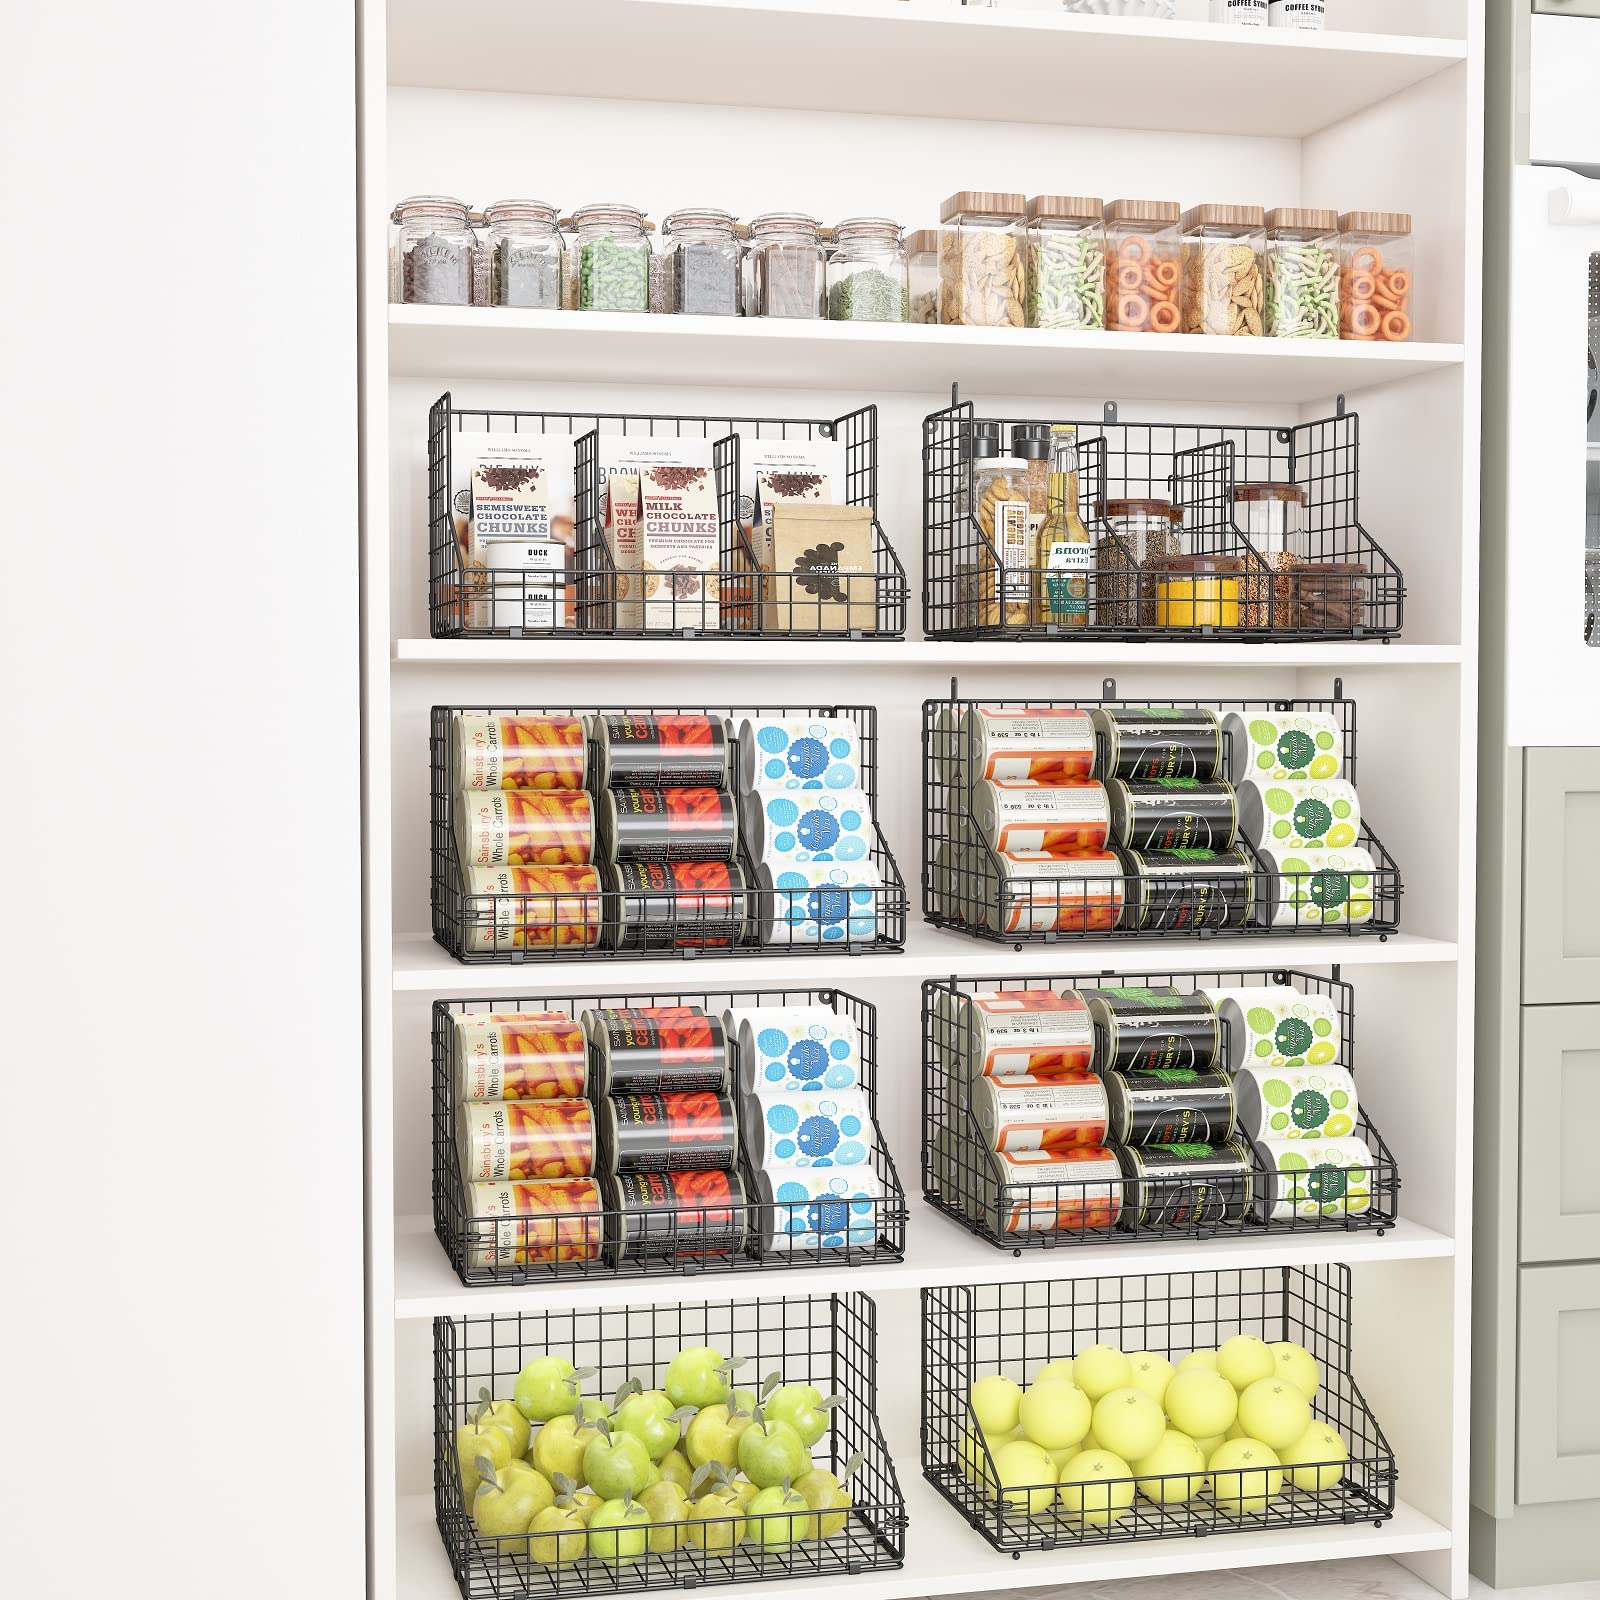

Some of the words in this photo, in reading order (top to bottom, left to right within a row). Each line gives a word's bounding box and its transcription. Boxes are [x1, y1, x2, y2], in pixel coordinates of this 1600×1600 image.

[476, 504, 546, 512] SEMISWEET
[477, 513, 547, 521] CHOCOLATE
[645, 502, 683, 511] MILK
[646, 512, 717, 521] CHOCOLATE
[477, 522, 547, 533] CHUNKS
[646, 521, 717, 533] CHUNKS
[1006, 509, 1016, 544] ALMOND
[1016, 510, 1024, 545] SMOKED
[486, 721, 497, 753] Carrots
[1288, 733, 1298, 768] Cupcake
[1300, 736, 1309, 758] Mix
[472, 731, 486, 787] Sainsbury's
[485, 756, 498, 786] Whole
[800, 740, 812, 777] Cupcake
[811, 744, 821, 767] Mix
[491, 796, 503, 827] Carrots
[630, 792, 643, 813] young
[1316, 805, 1325, 827] Mix
[478, 807, 492, 863] Sainsbury's
[809, 812, 820, 850] Cupcake
[821, 816, 831, 839] Mix
[1305, 801, 1315, 838] Cupcake
[491, 832, 504, 863] Whole
[497, 872, 509, 906] Crrots
[638, 868, 651, 890] young
[1323, 873, 1333, 907] Cupcak
[487, 1031, 498, 1065] Carrots
[1286, 1021, 1296, 1056] Cupcake
[1297, 1024, 1306, 1047] Mix
[473, 1043, 485, 1098] Sainsbury's
[800, 1042, 810, 1080] Cupcake
[811, 1046, 820, 1070] Mix
[487, 1065, 499, 1097] Whole
[630, 1101, 643, 1125] young
[1302, 1092, 1312, 1128] Cupcake
[1313, 1097, 1322, 1119] Mix
[493, 1110, 503, 1144] Carrots
[810, 1119, 820, 1157] Cupcake
[822, 1122, 832, 1145] Mix
[479, 1123, 491, 1178] Sainsbury's
[493, 1146, 505, 1178] Whole
[639, 1181, 651, 1205] young
[1320, 1167, 1330, 1202] Cupcak
